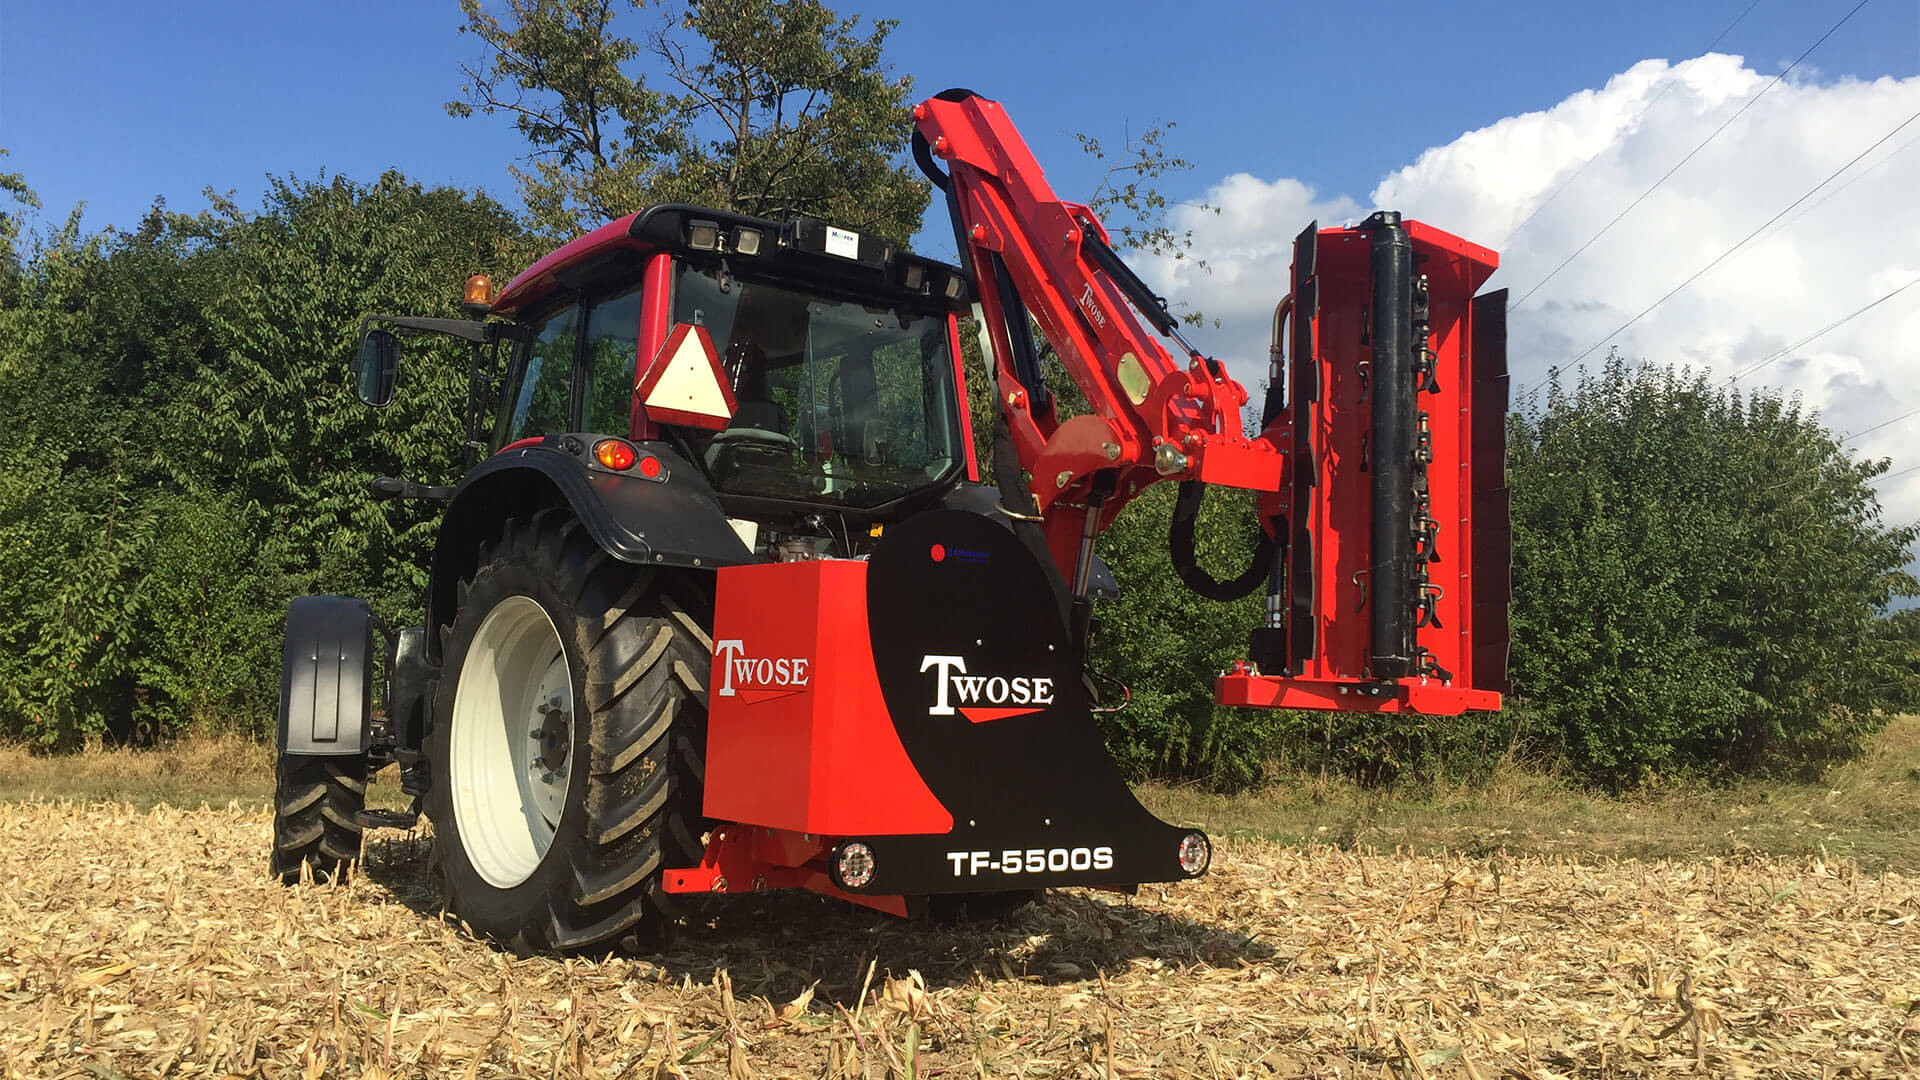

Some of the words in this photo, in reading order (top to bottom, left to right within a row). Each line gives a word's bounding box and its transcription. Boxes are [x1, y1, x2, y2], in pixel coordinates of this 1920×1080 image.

[1080, 282, 1105, 328] TWOSE
[715, 639, 809, 696] TWOSE
[919, 655, 1055, 716] TWOSE
[947, 847, 1113, 877] TF-5500S
